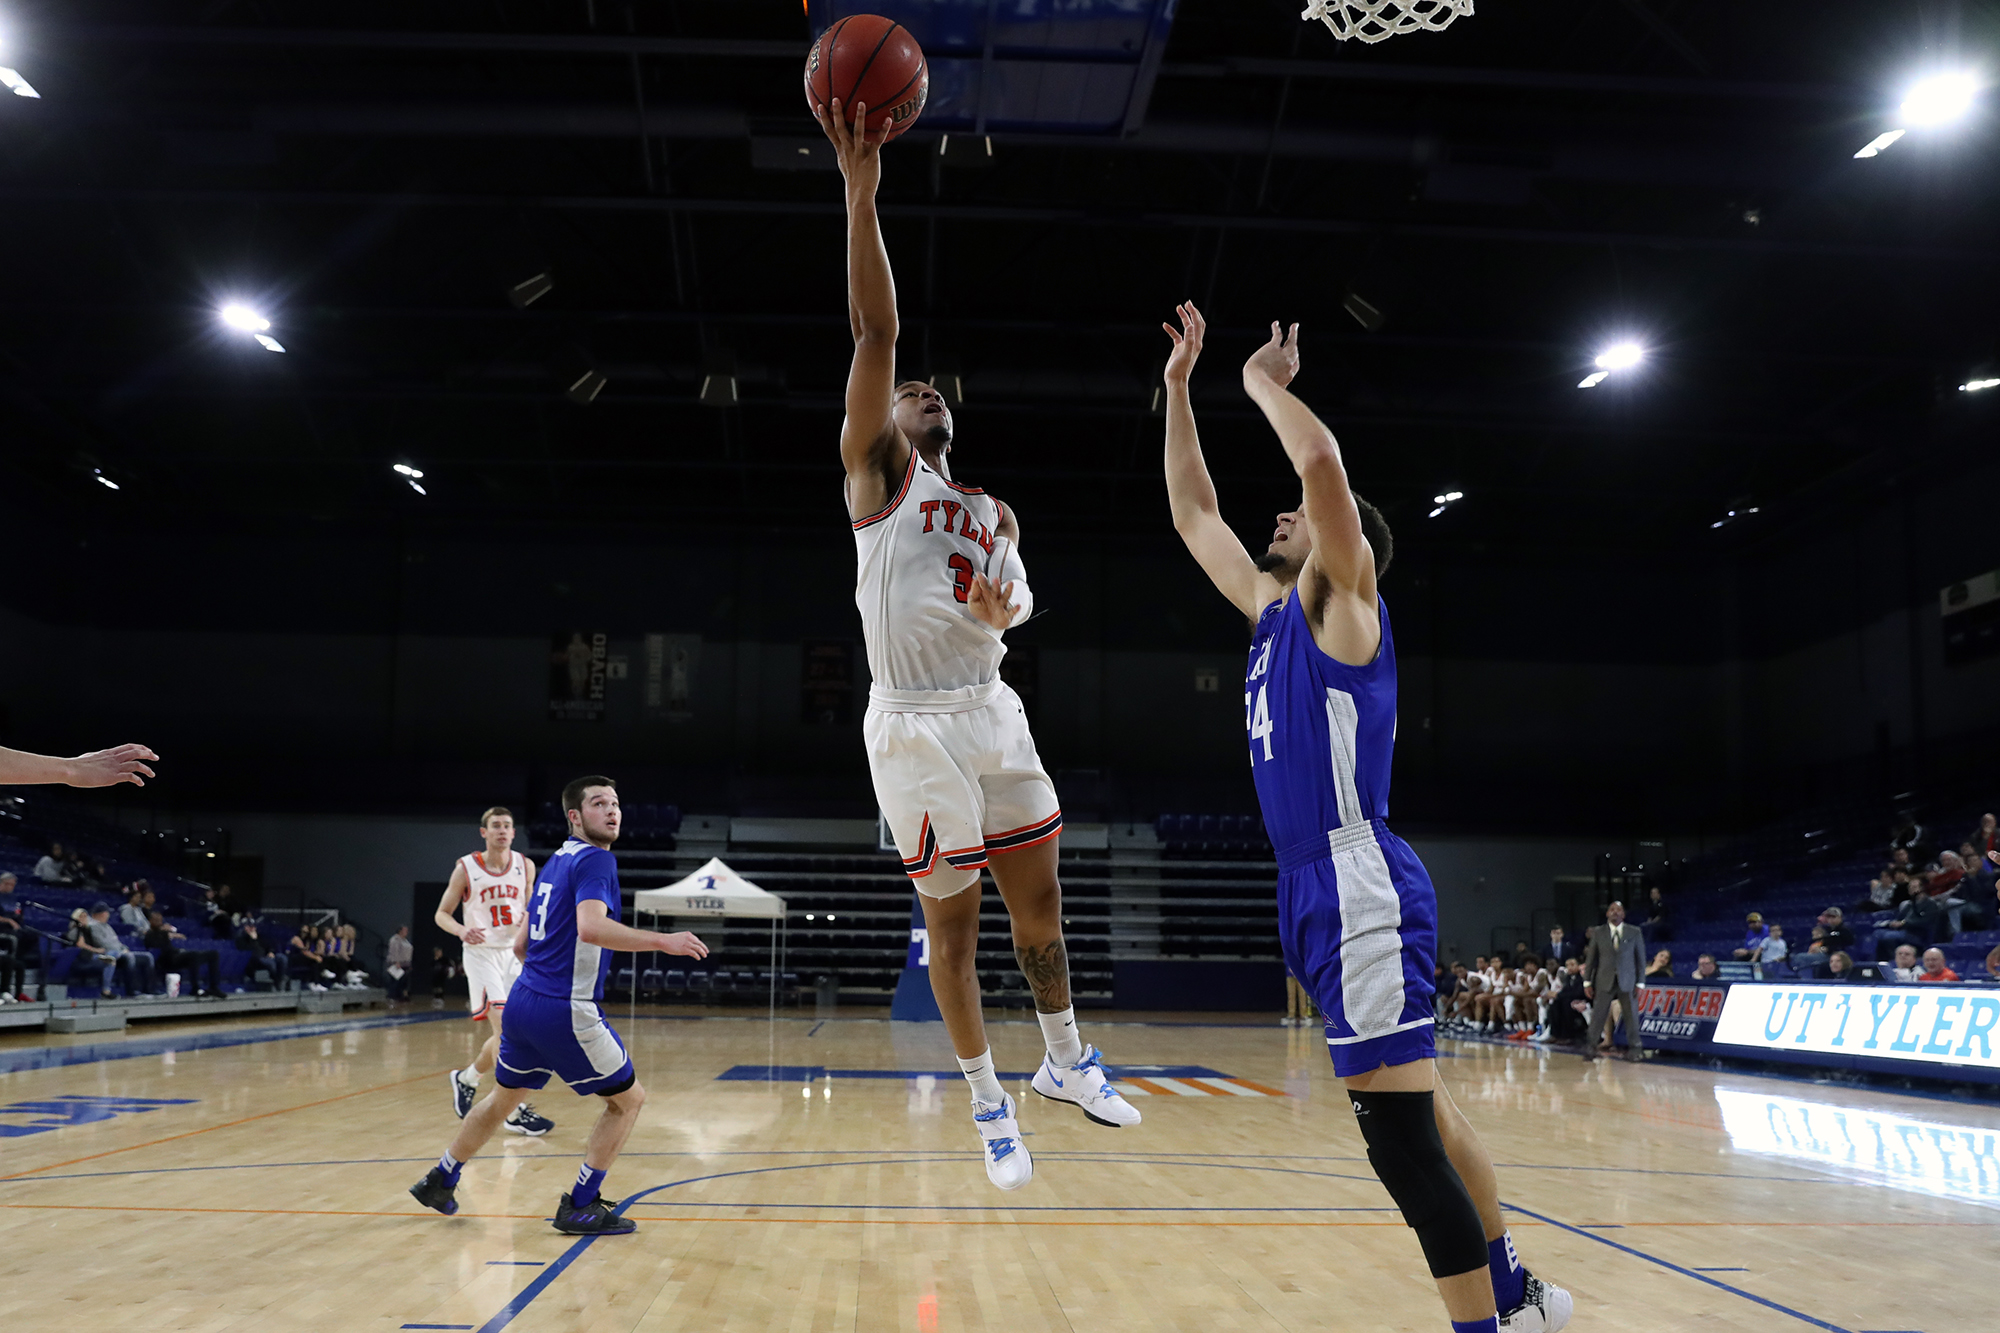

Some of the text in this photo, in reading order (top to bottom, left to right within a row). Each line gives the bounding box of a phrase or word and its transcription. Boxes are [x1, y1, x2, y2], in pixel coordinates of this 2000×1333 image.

[948, 552, 974, 604] 3
[479, 884, 519, 904] TYLER
[686, 897, 725, 909] TYLER
[490, 904, 513, 928] 15
[530, 881, 554, 941] 3
[1640, 1019, 1697, 1036] PATRIOTS
[1764, 992, 1827, 1043] UT
